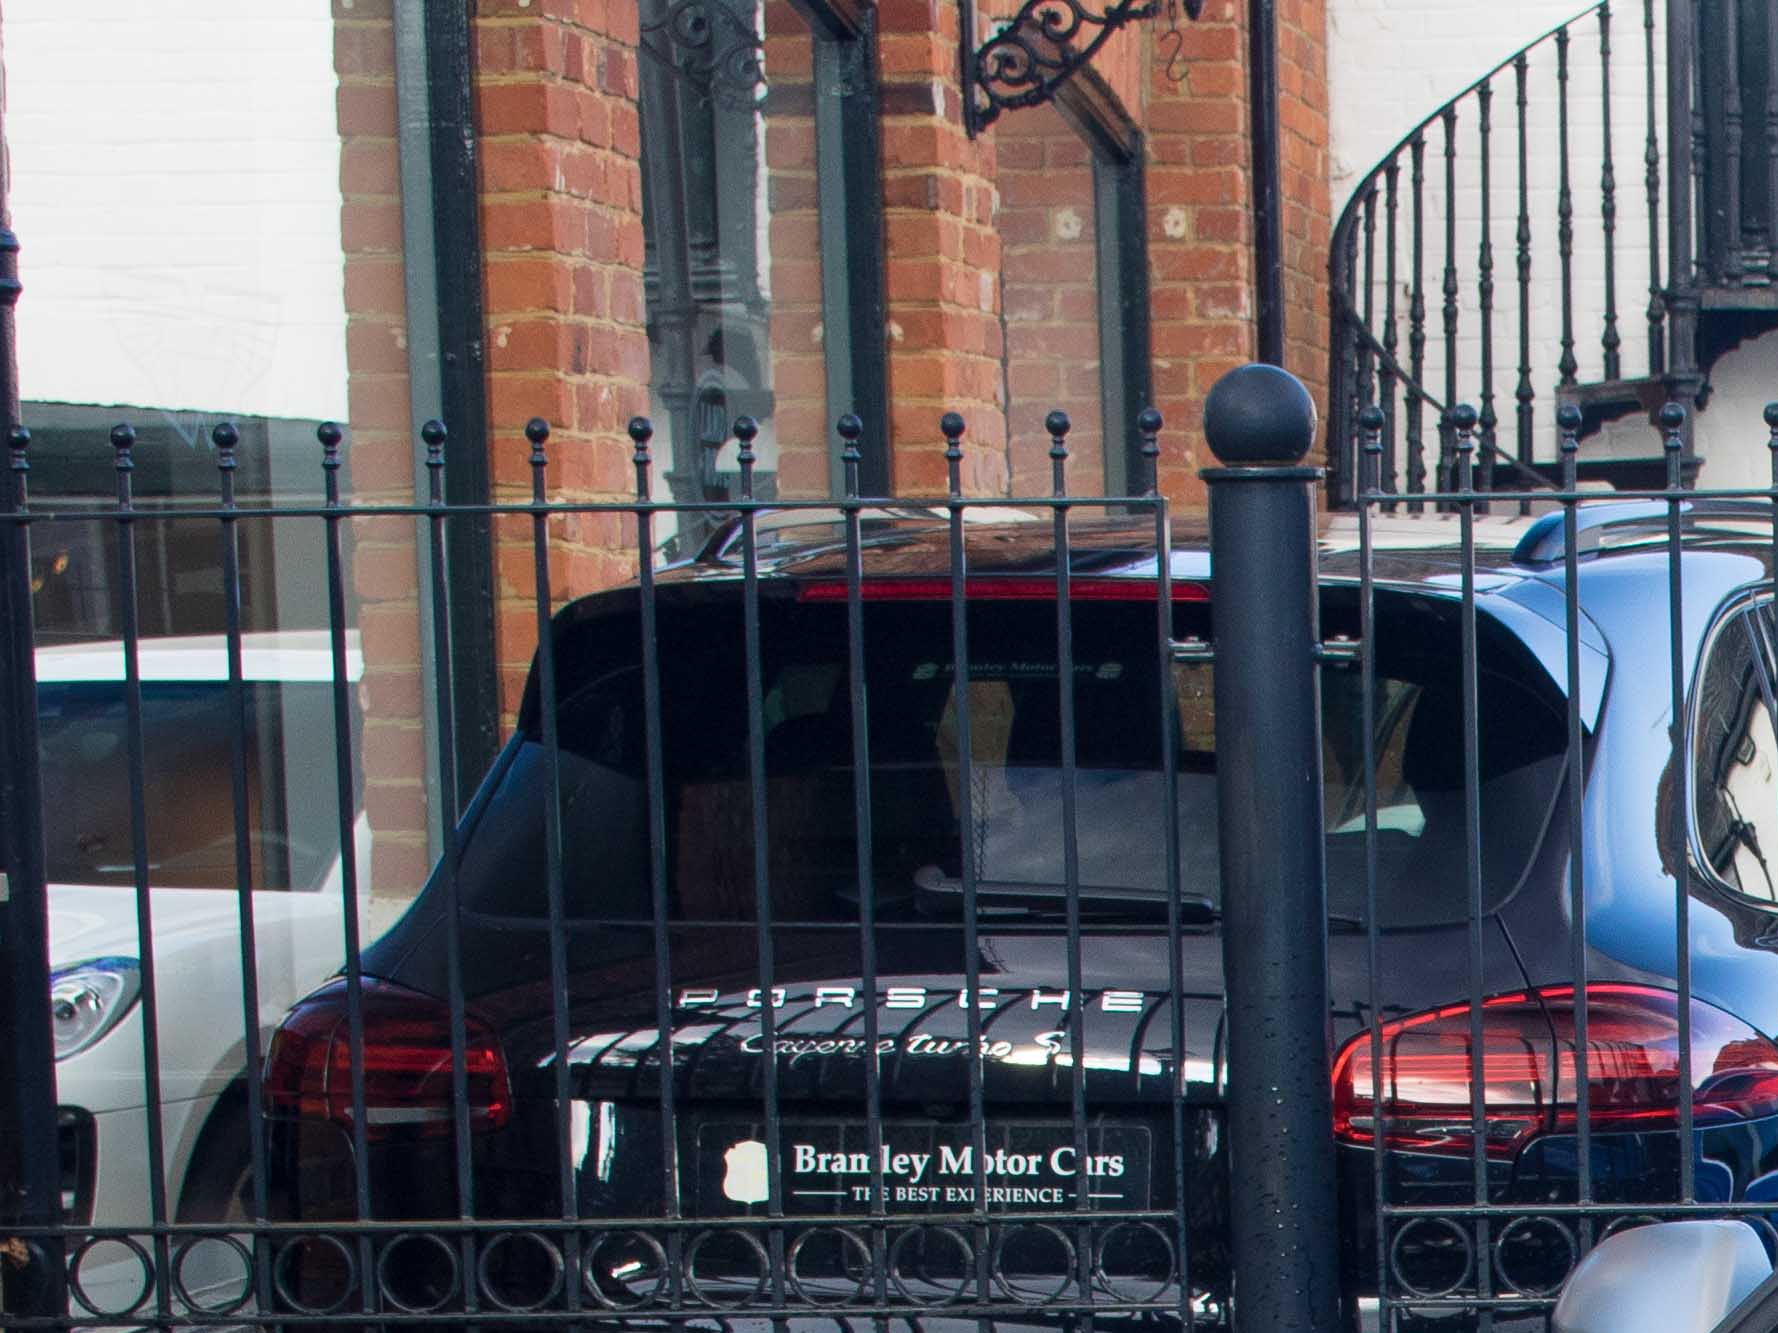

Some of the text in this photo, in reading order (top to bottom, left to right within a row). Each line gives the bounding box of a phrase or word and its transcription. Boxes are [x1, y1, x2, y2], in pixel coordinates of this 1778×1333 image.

[679, 987, 1145, 1013] PORSCHE
[1033, 1030, 1067, 1056] S
[792, 1143, 931, 1184] Bramley
[895, 1186, 941, 1202] BEST
[945, 1186, 1065, 1204] EXERIENCE
